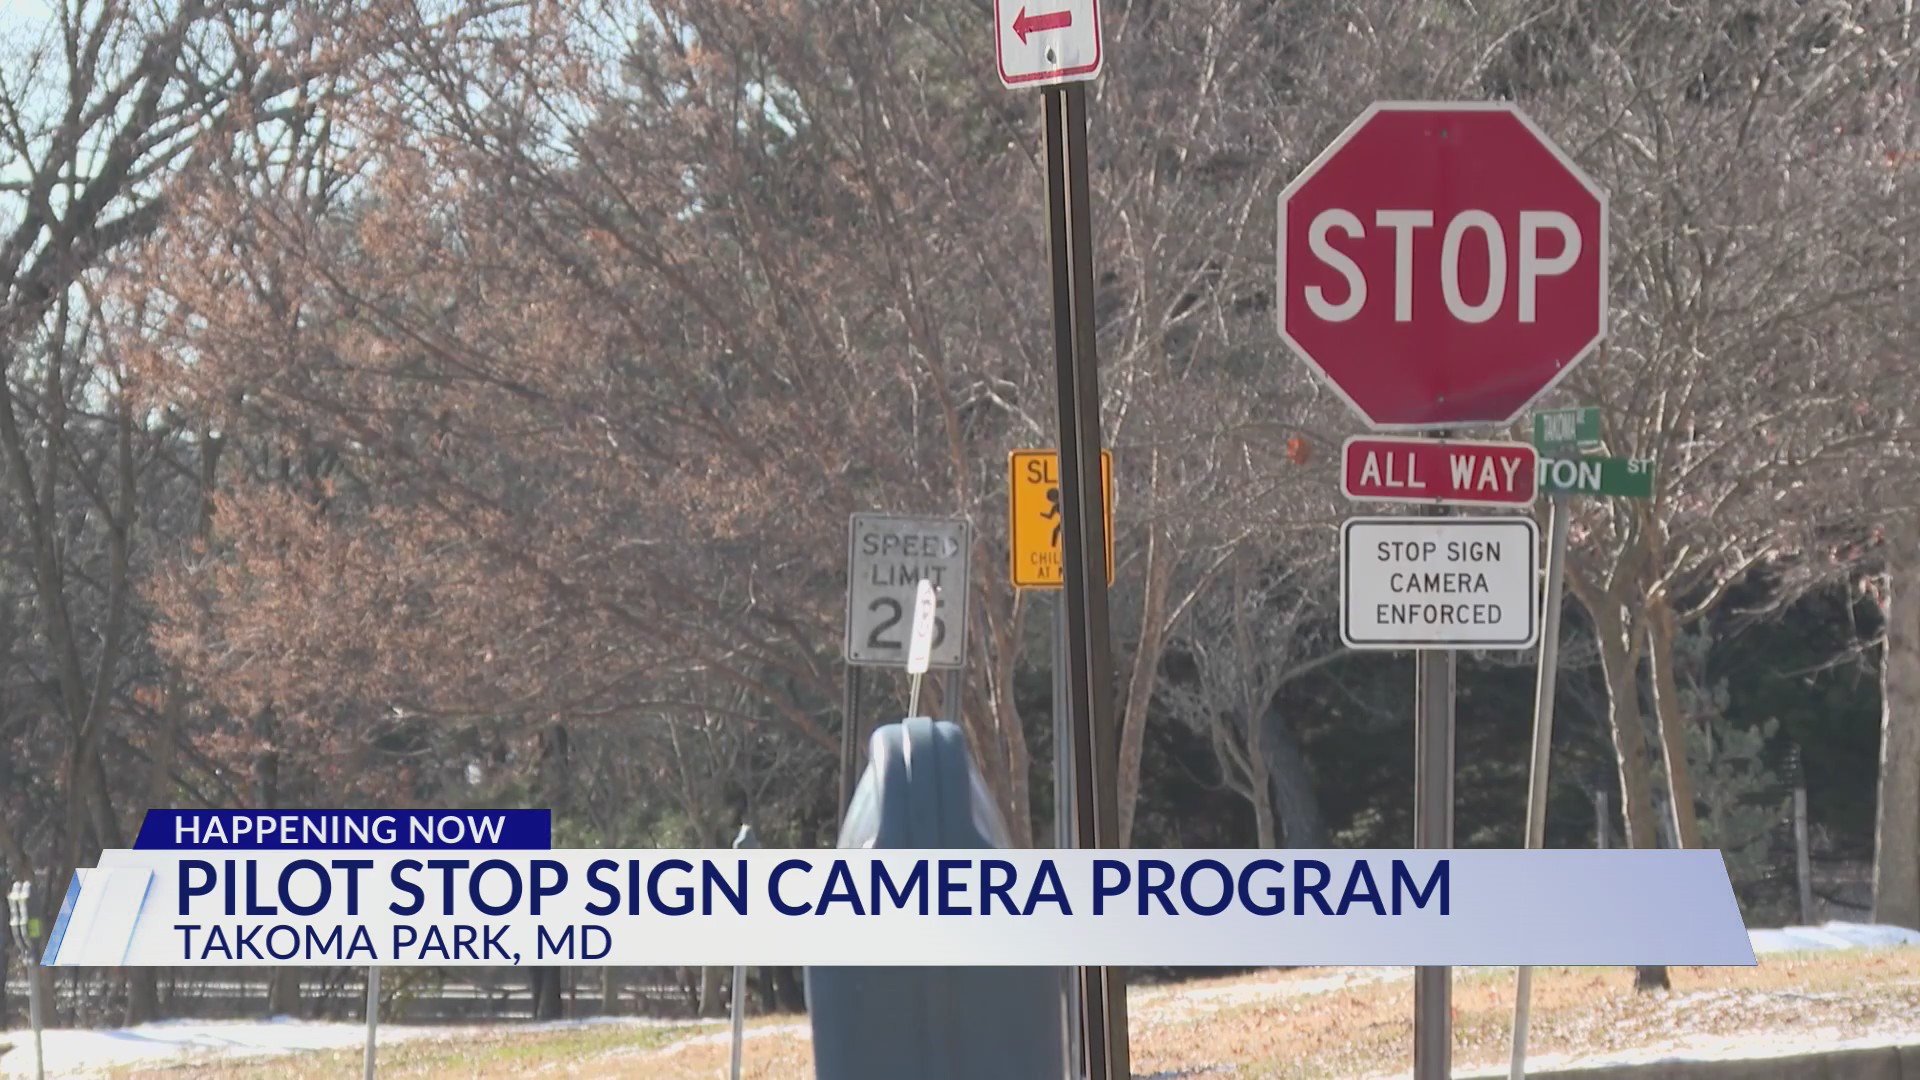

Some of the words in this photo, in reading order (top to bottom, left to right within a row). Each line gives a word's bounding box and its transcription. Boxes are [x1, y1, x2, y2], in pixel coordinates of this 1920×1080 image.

[1304, 208, 1582, 323] STOP
[1027, 459, 1058, 484] SL
[1360, 450, 1426, 489] ALL
[1450, 454, 1521, 492] WAY
[1539, 458, 1601, 490] TON
[1627, 459, 1651, 474] ST
[863, 532, 959, 558] SPEED
[1377, 541, 1436, 562] STOP
[1447, 541, 1501, 562] SIGN
[1031, 551, 1060, 565] CHIL
[872, 563, 947, 588] LIMIT
[1390, 572, 1489, 593] CAMERA
[1377, 604, 1502, 625] ENFORCED
